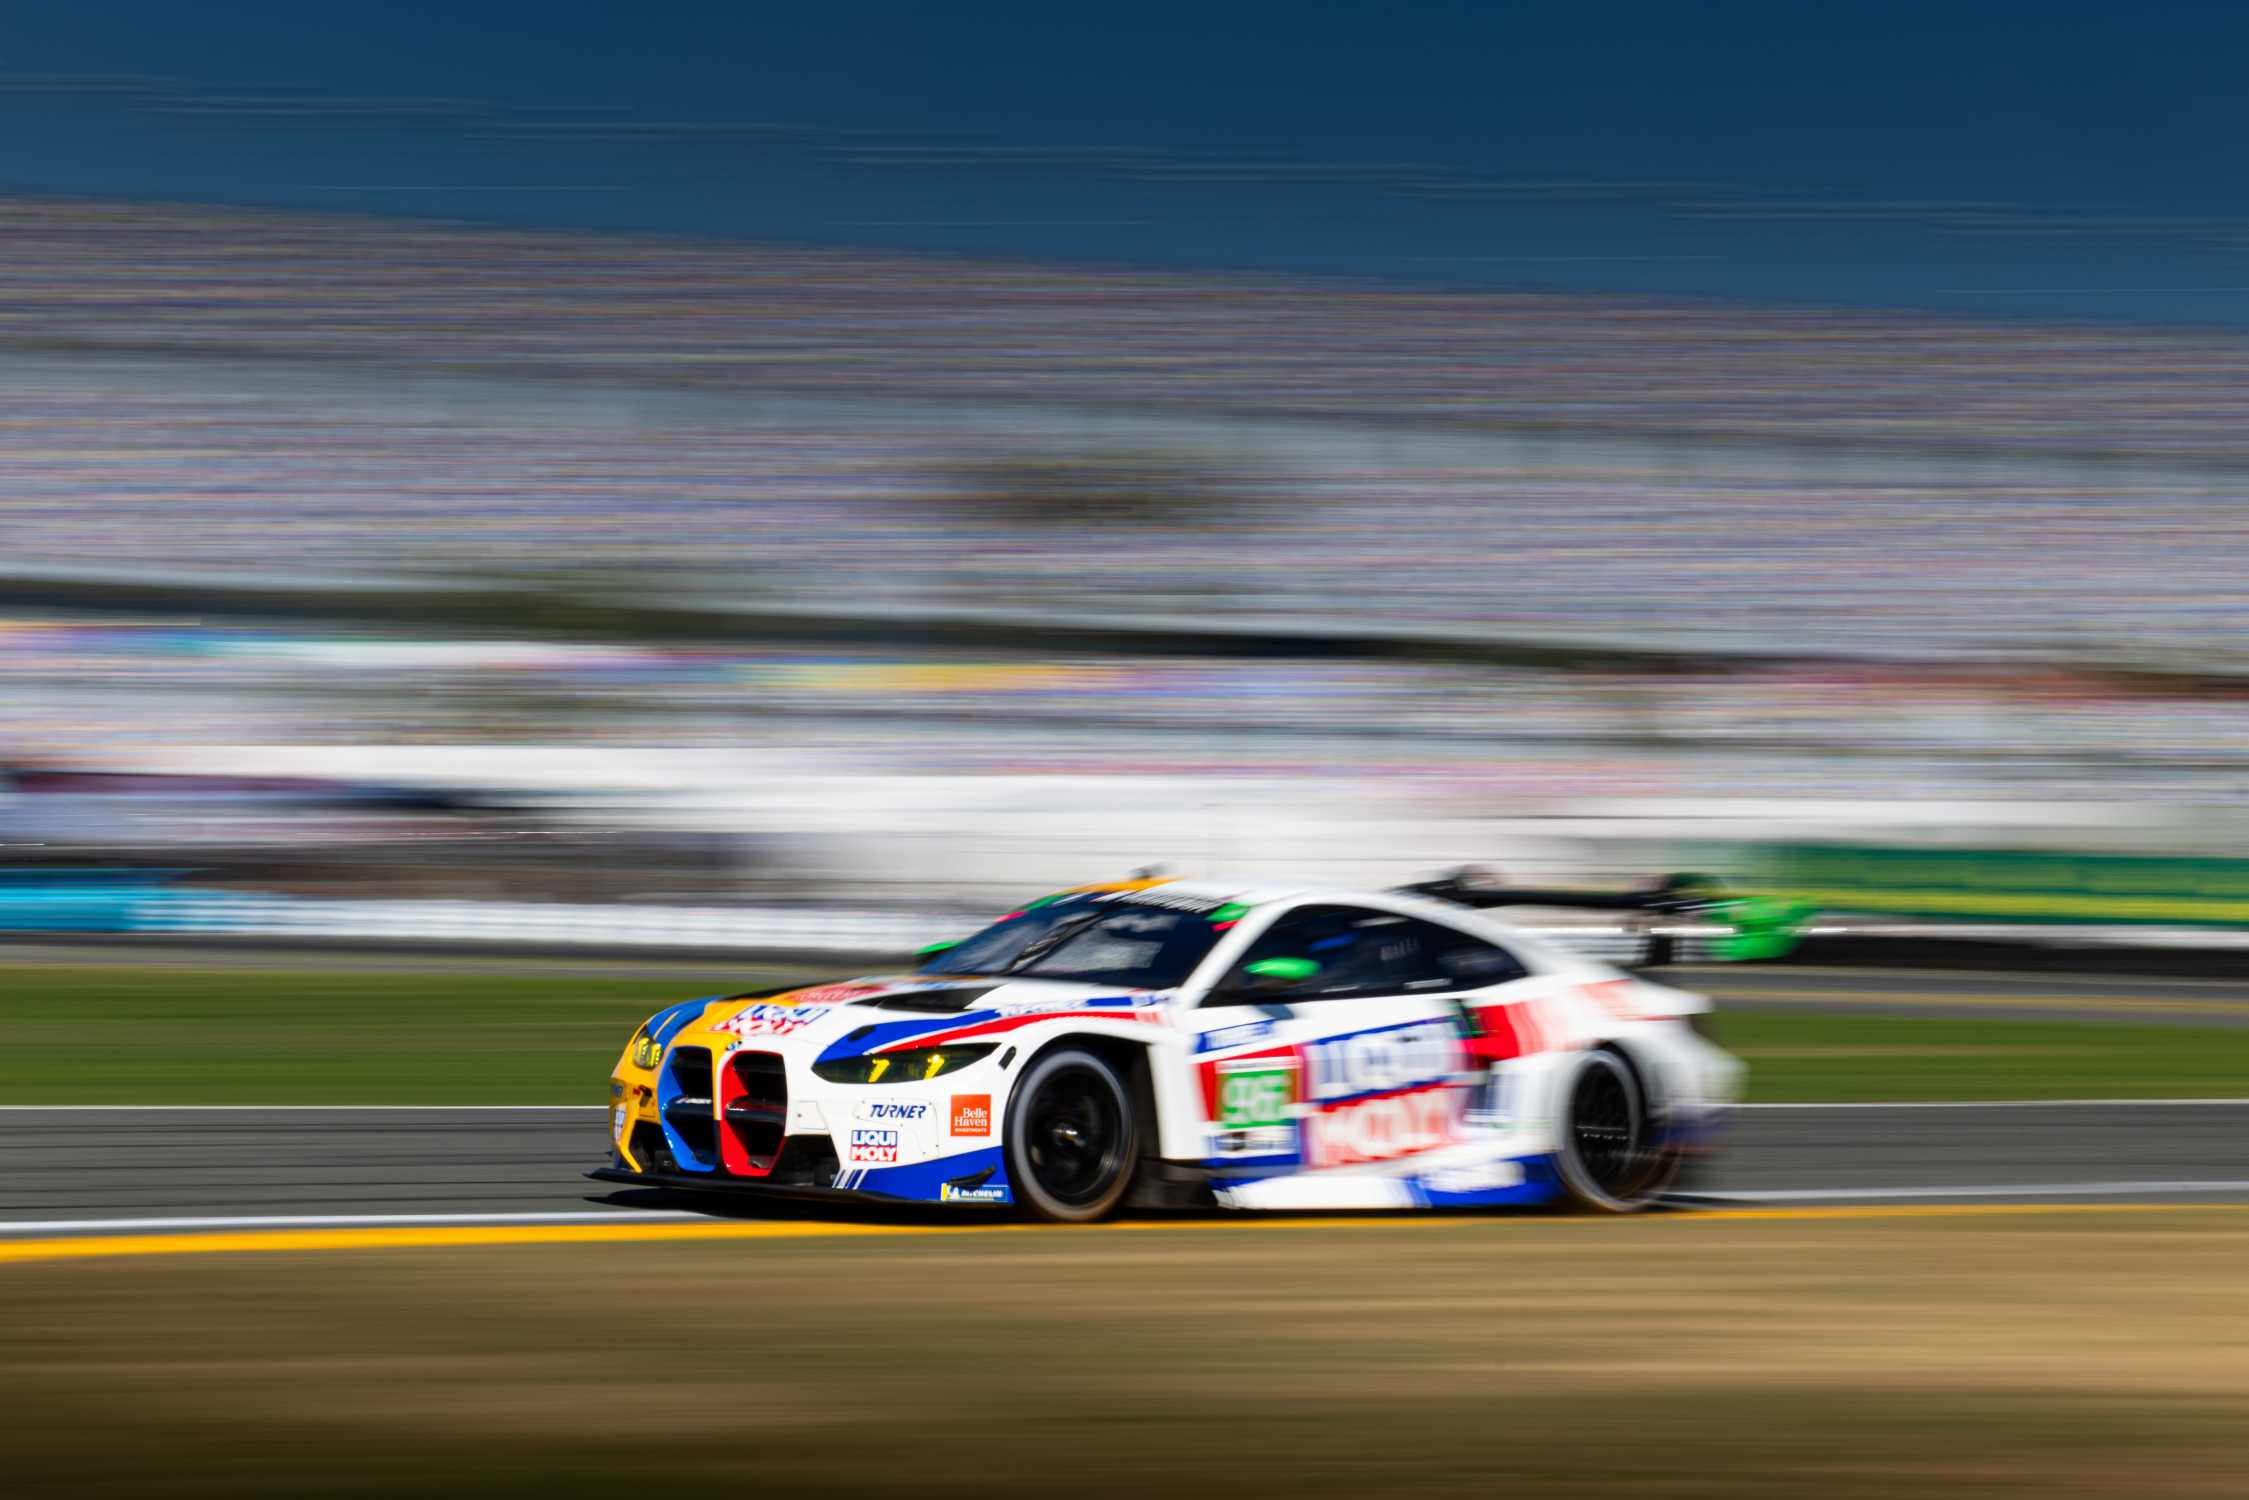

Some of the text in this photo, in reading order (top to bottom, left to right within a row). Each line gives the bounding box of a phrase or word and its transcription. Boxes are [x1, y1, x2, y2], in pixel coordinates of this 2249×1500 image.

[869, 1104, 927, 1119] TURNER
[963, 1107, 988, 1118] Belle
[954, 1115, 988, 1127] Haven
[852, 1131, 897, 1146] LIQUI
[851, 1146, 897, 1161] MOLY
